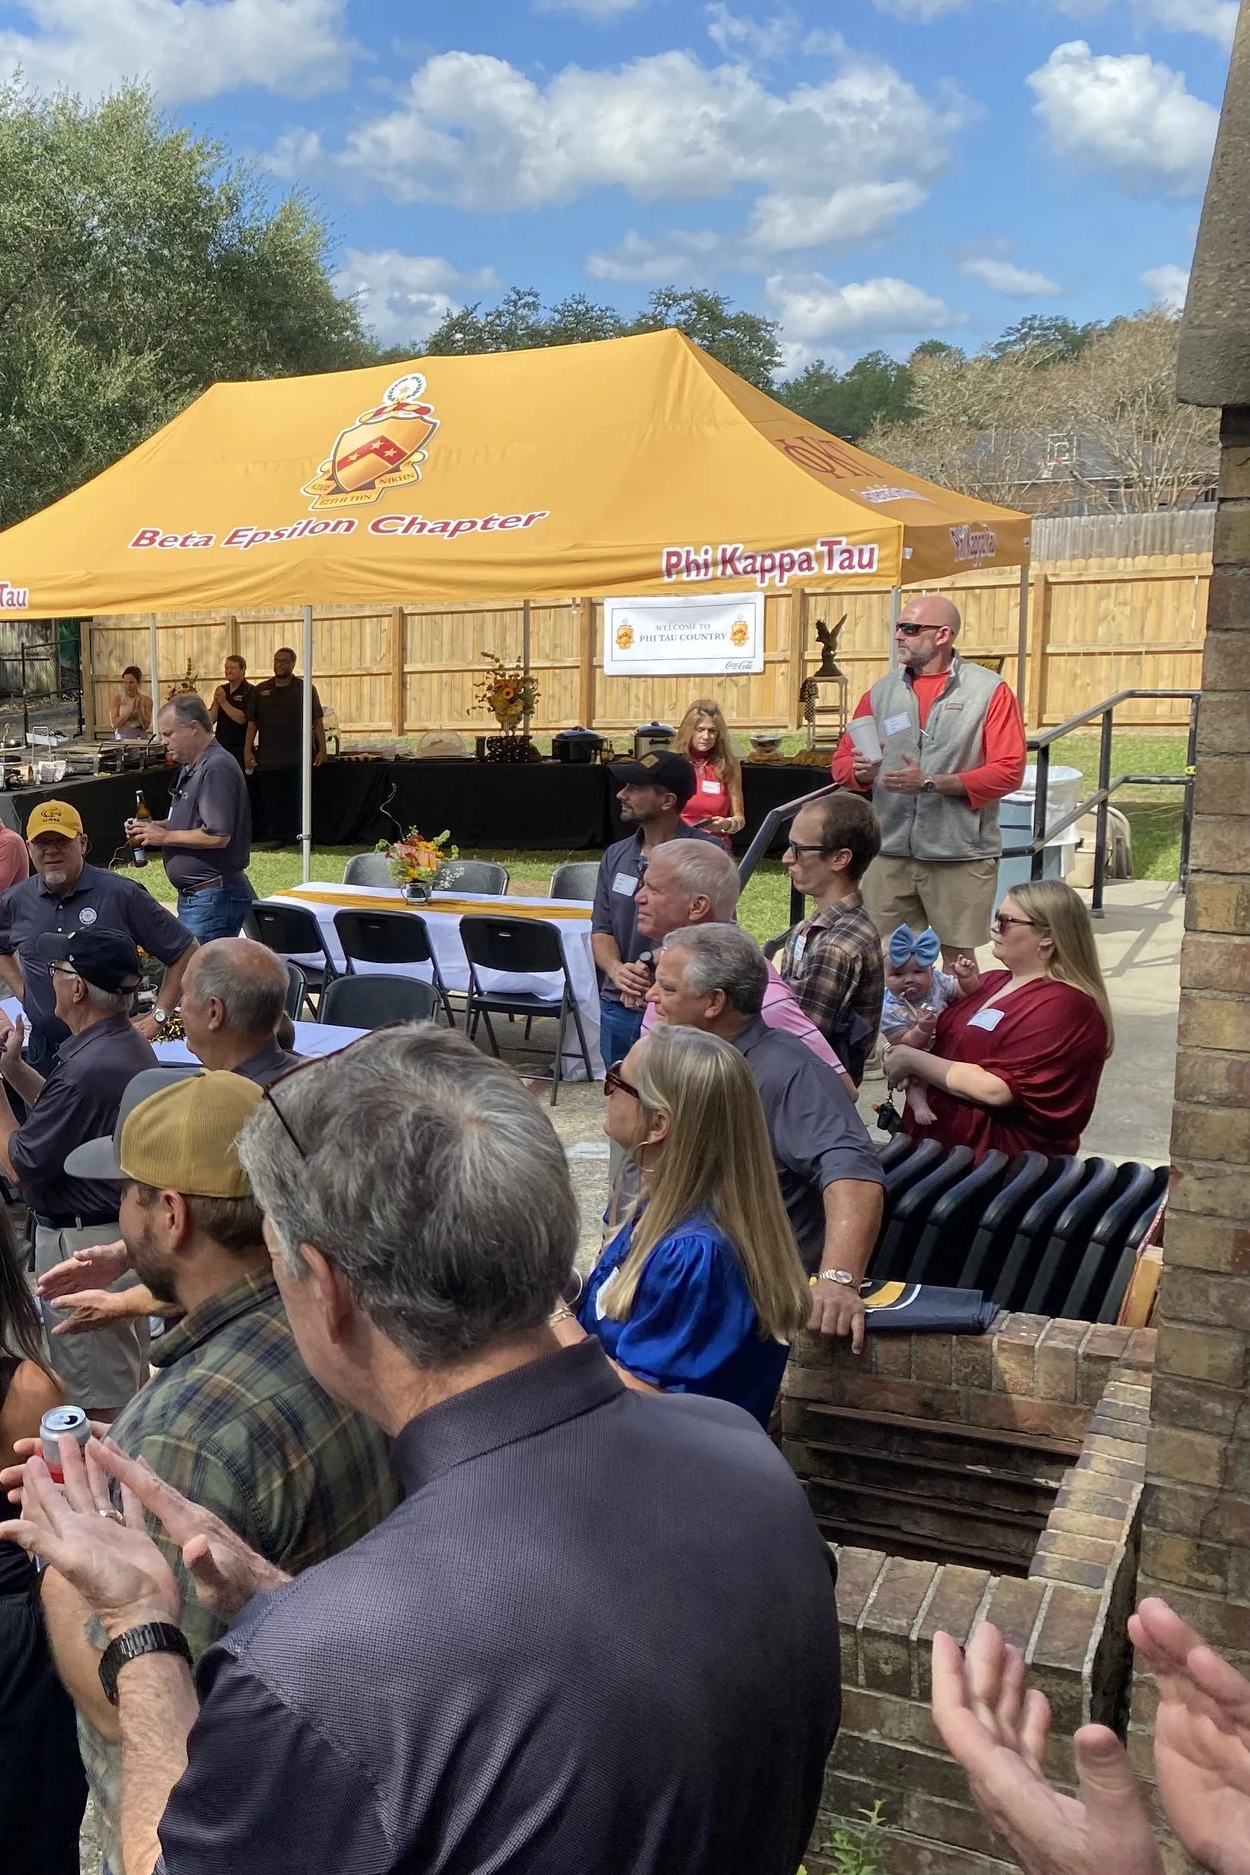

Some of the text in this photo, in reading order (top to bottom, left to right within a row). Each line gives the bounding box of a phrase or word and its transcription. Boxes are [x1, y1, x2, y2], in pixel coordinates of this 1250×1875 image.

[130, 511, 547, 549] Beta Epsilon Chapter
[665, 540, 875, 583] Phi Kappa Tau
[639, 632, 727, 643] PHI TAU COUNTRY
[655, 624, 696, 632] WELCOME
